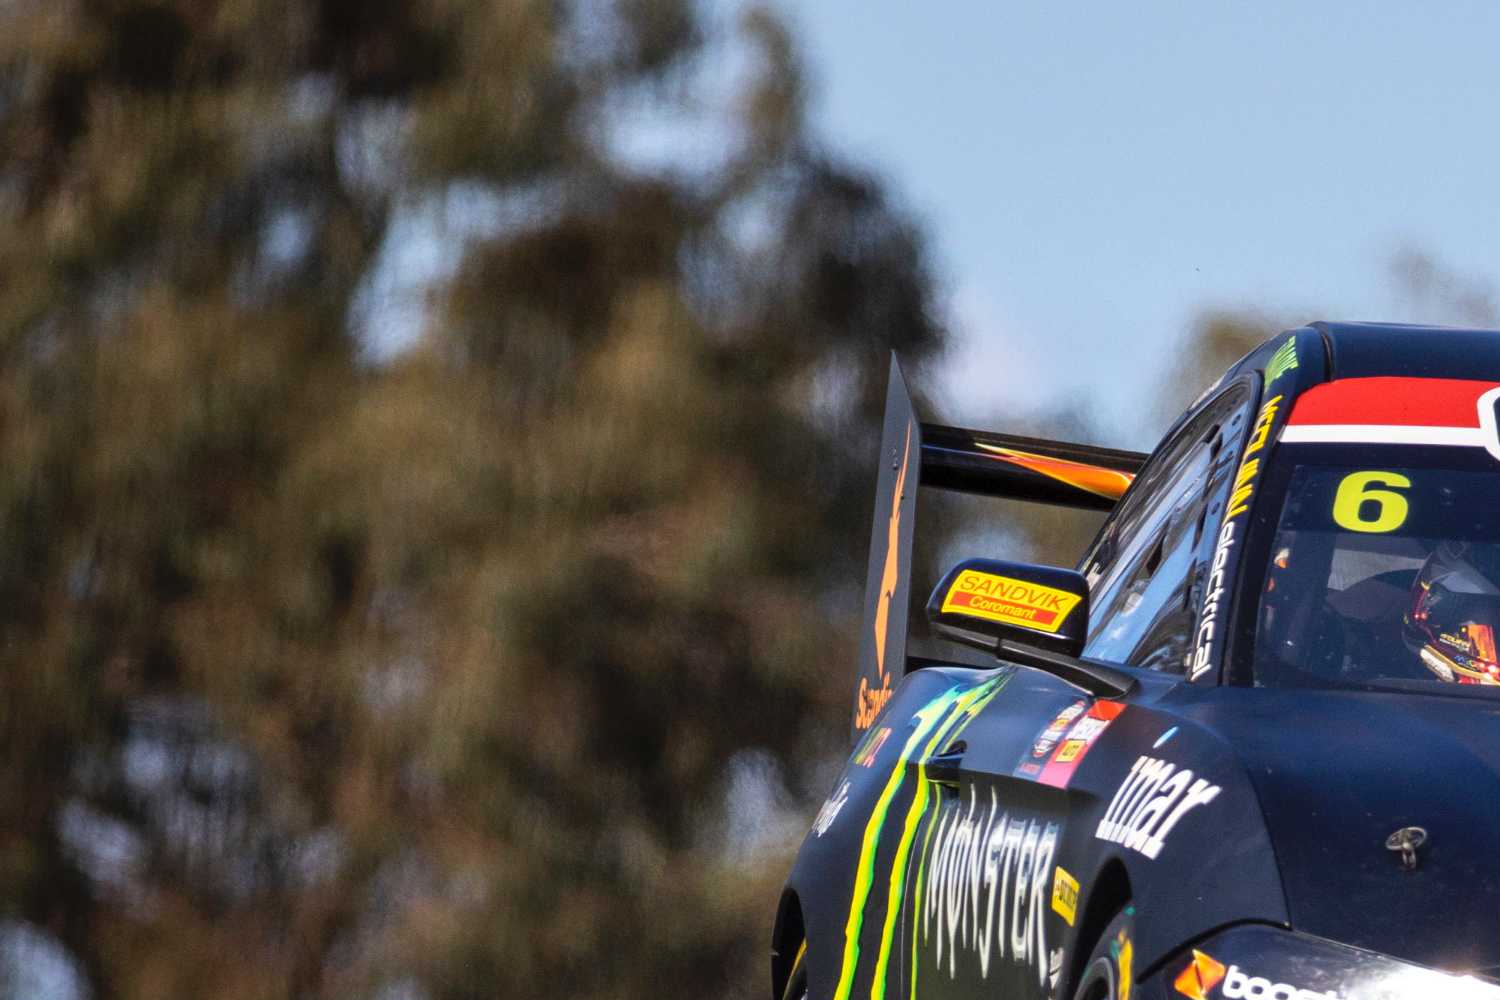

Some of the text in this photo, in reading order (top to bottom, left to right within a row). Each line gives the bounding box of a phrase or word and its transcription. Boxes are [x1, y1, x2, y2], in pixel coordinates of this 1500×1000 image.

[1332, 470, 1411, 533] 6
[959, 575, 1069, 611] SANDVIK
[969, 595, 1037, 619] Coromant
[1190, 520, 1237, 683] electrical
[923, 784, 1059, 988] MONSTER
